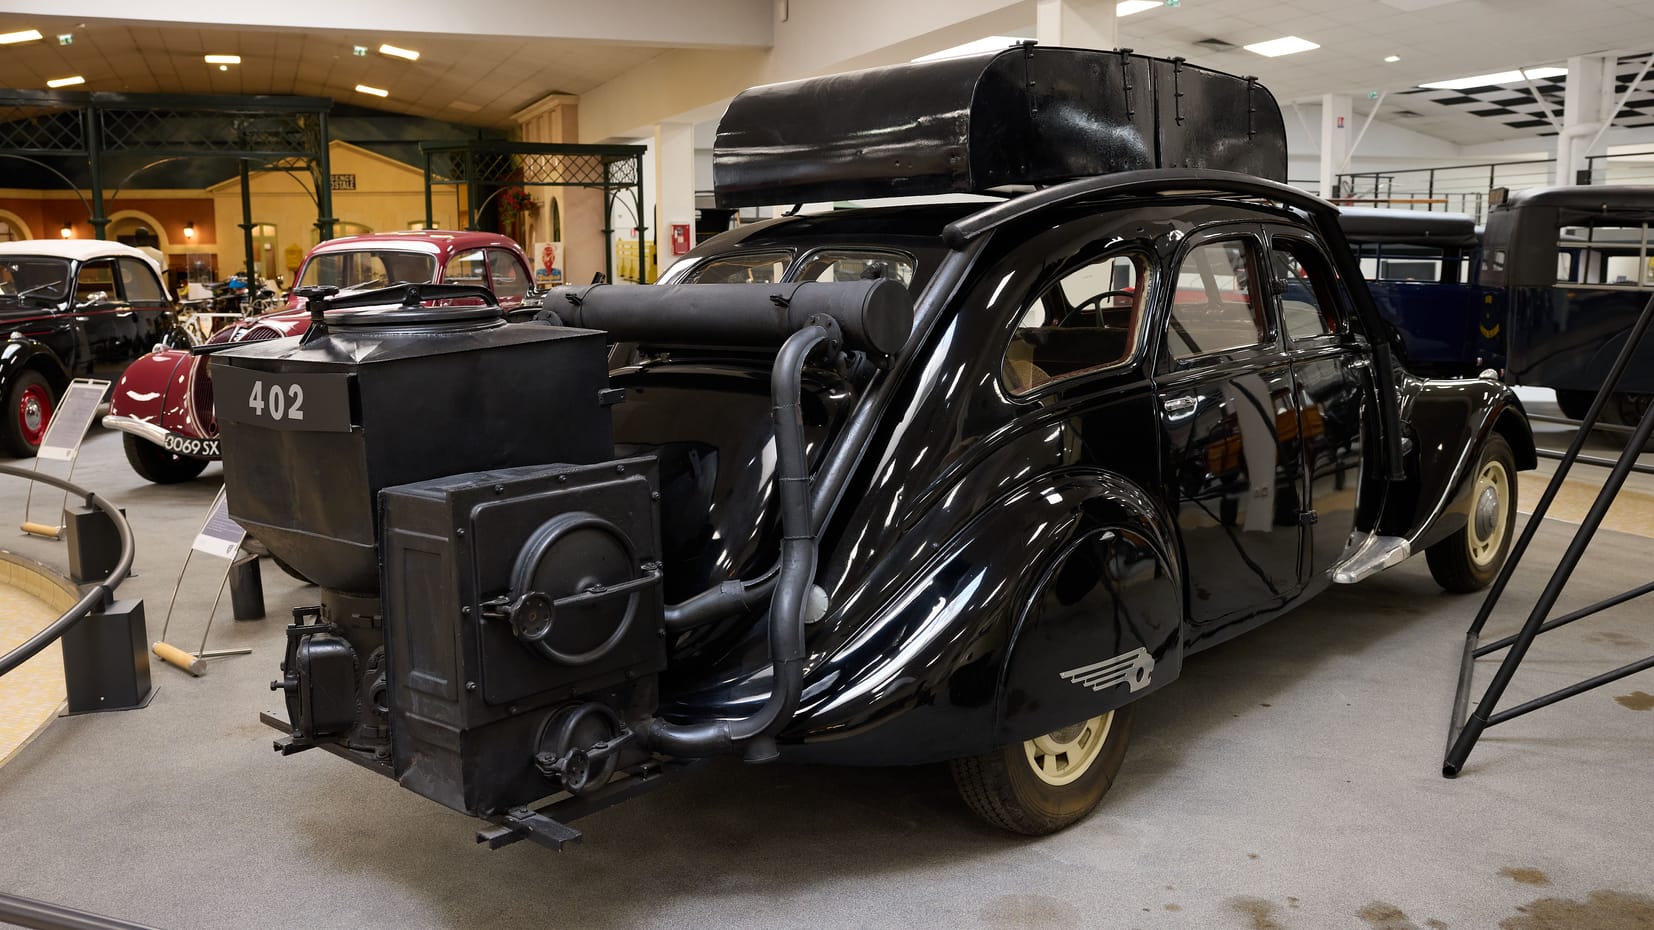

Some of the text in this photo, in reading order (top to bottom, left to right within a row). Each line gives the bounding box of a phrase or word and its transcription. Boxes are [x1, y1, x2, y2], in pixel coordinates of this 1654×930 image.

[249, 380, 304, 420] 402
[165, 436, 220, 455] 3069 SX
